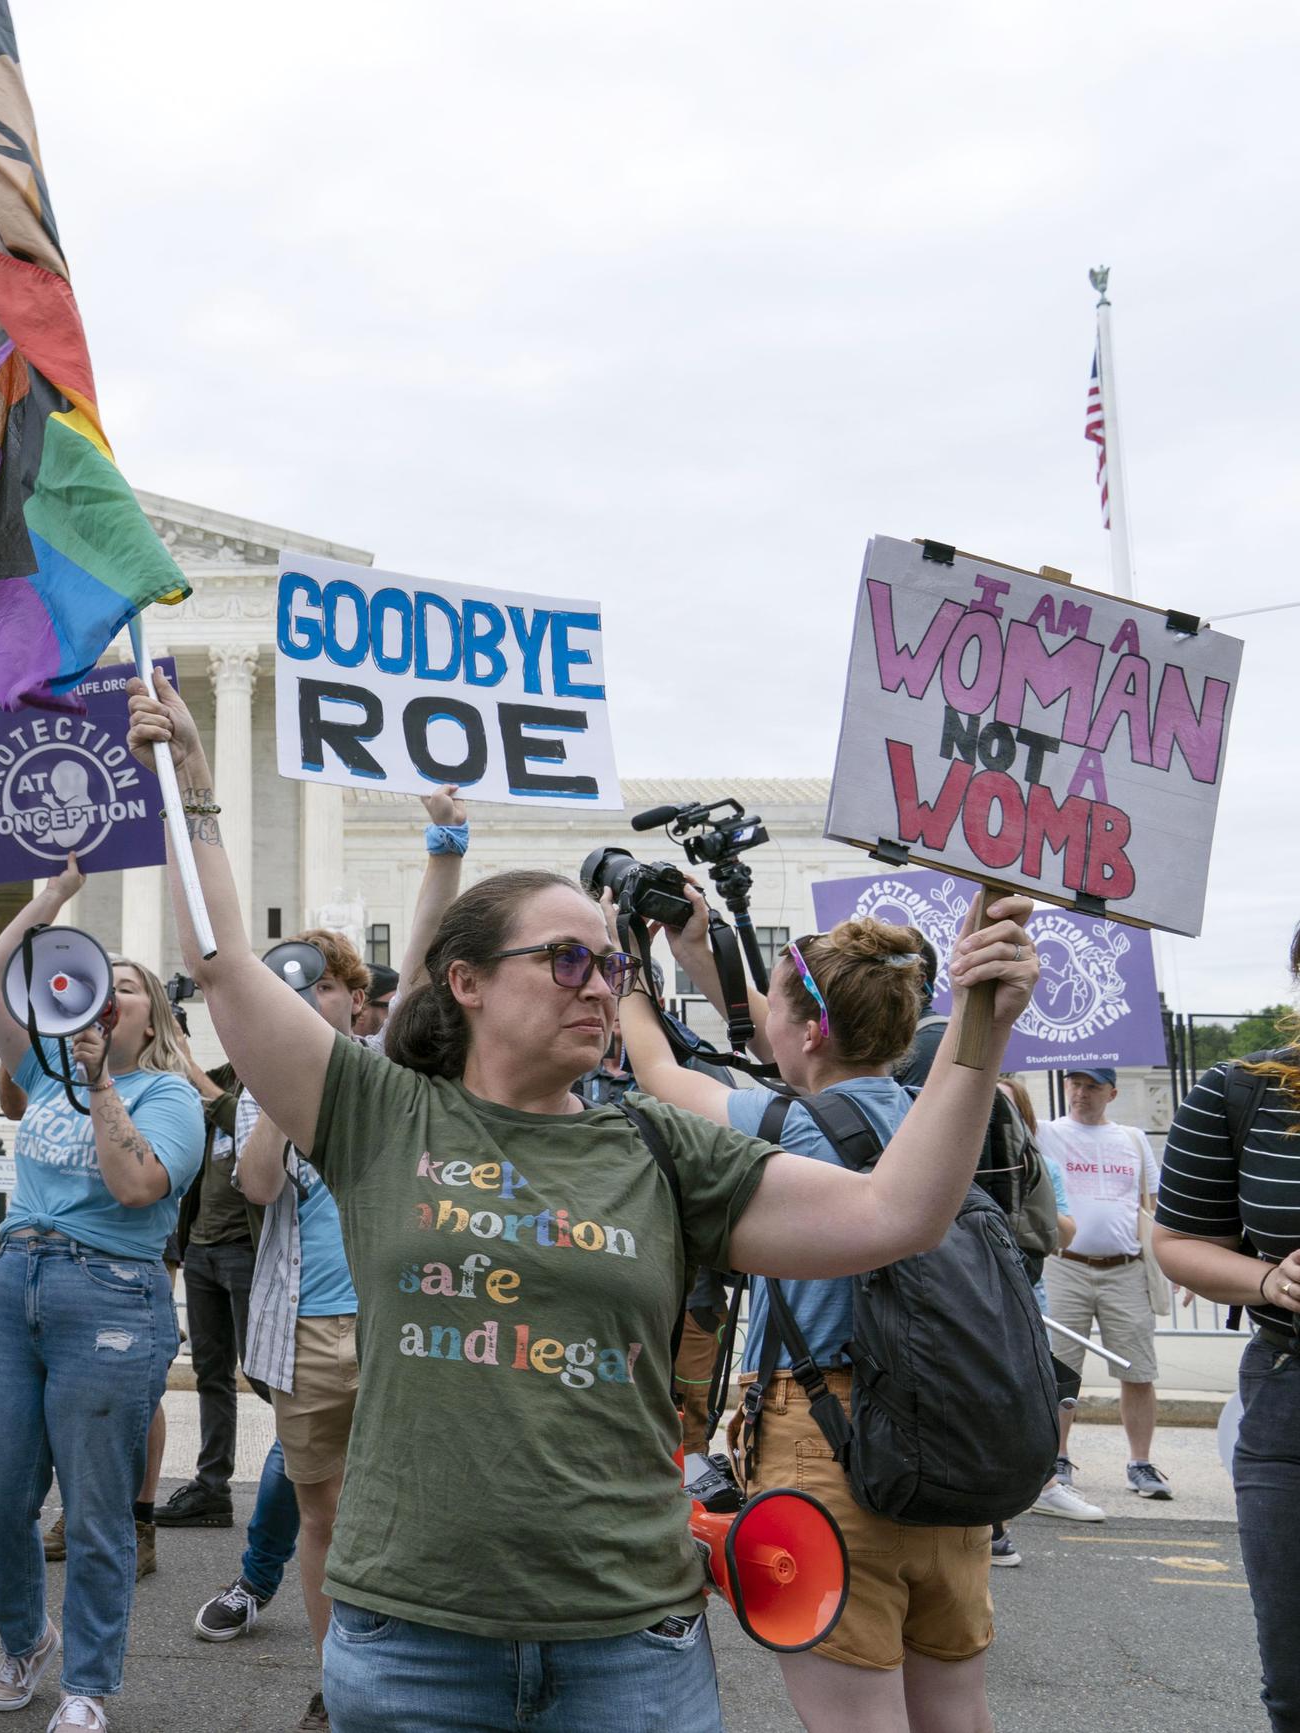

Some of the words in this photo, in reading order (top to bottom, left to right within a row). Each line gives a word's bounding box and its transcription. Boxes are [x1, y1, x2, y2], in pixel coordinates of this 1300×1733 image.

[277, 571, 606, 700] GOODBYE
[970, 573, 1011, 619] I
[1027, 593, 1093, 639] AM
[1109, 618, 1141, 656] A
[866, 577, 1230, 785] WOMAN
[296, 676, 599, 800] ROE
[939, 704, 1061, 784] NOT
[1066, 748, 1109, 804] A
[17, 773, 48, 794] AT
[885, 737, 1136, 900] WOMB
[1025, 915, 1094, 952] TECTION
[1037, 998, 1132, 1044] CONCEPTION
[1026, 1052, 1119, 1065] StudentsforLife.org
[1066, 1162, 1099, 1173] SAVE
[1102, 1164, 1134, 1177] LIVES
[398, 1253, 521, 1304] safe
[399, 1321, 500, 1366] and
[511, 1323, 643, 1389] legal
